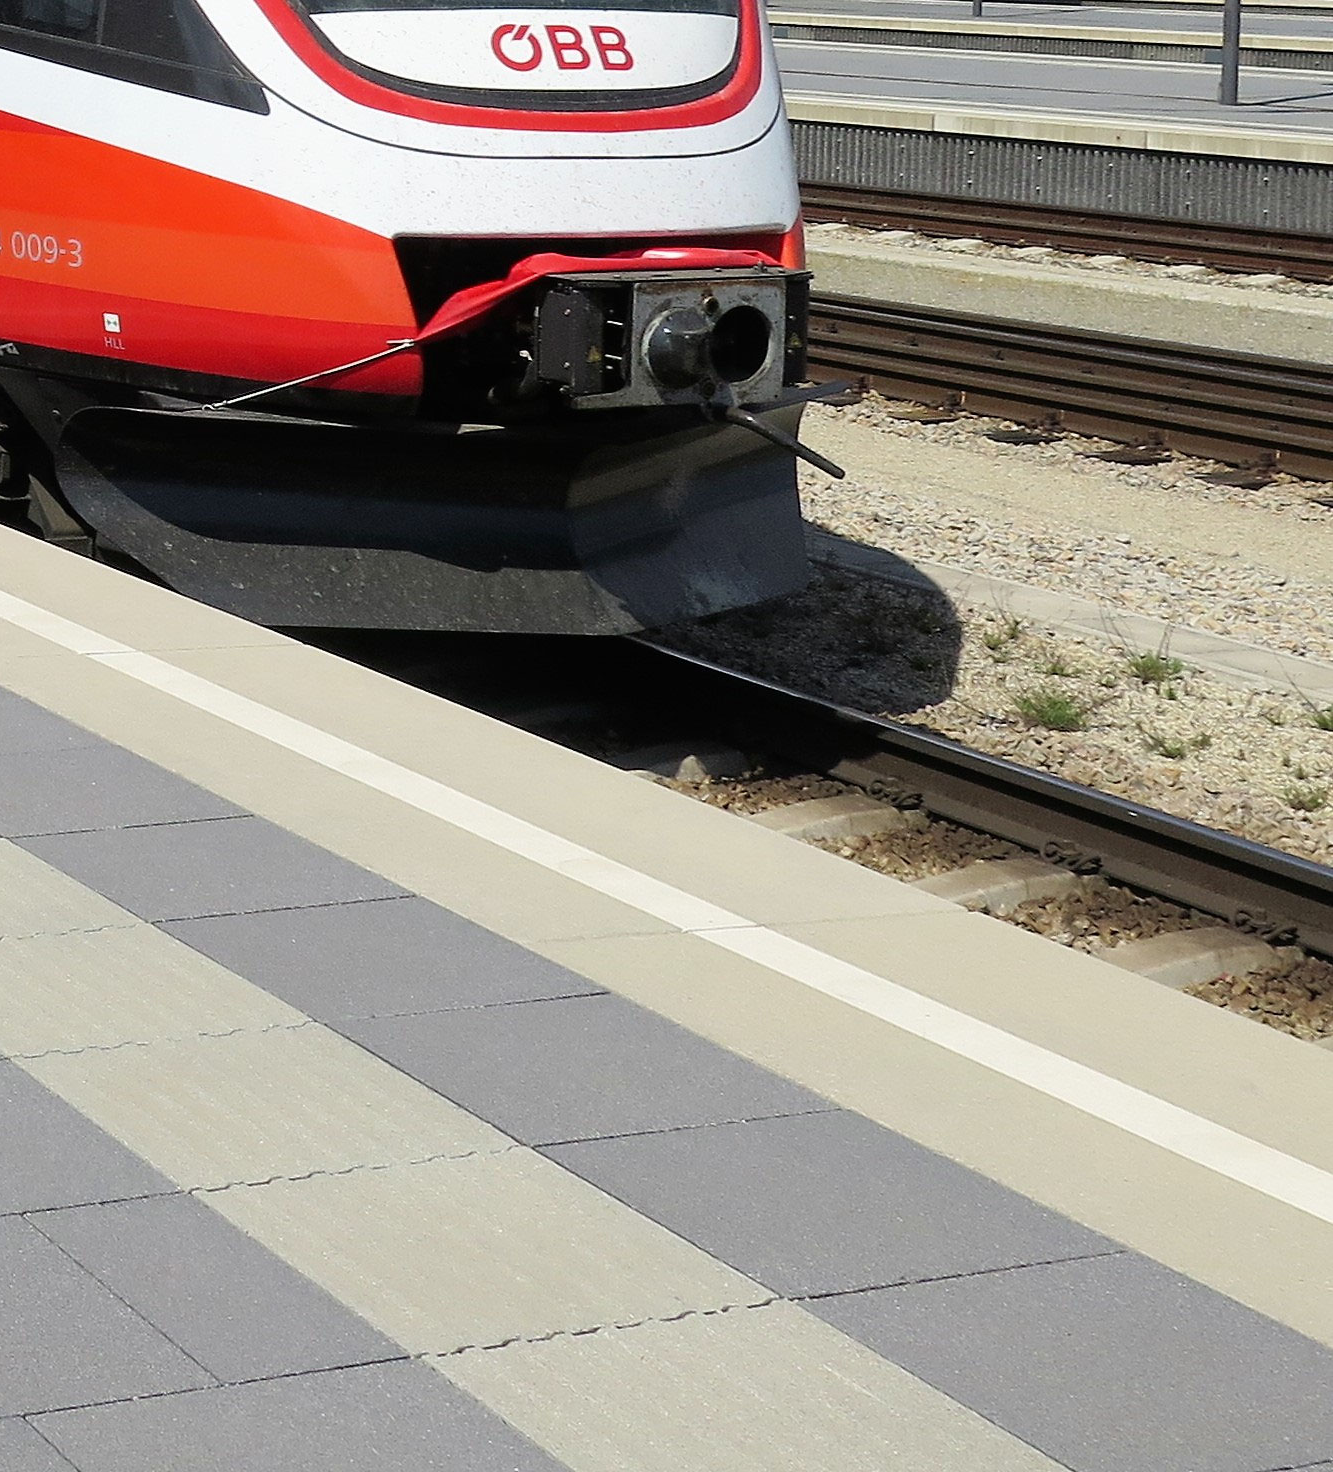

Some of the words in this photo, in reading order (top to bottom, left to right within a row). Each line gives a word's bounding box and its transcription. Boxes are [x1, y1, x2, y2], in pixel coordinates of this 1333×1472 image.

[490, 23, 635, 72] ÖBB
[11, 231, 83, 268] 009-3
[104, 336, 126, 350] HLL
